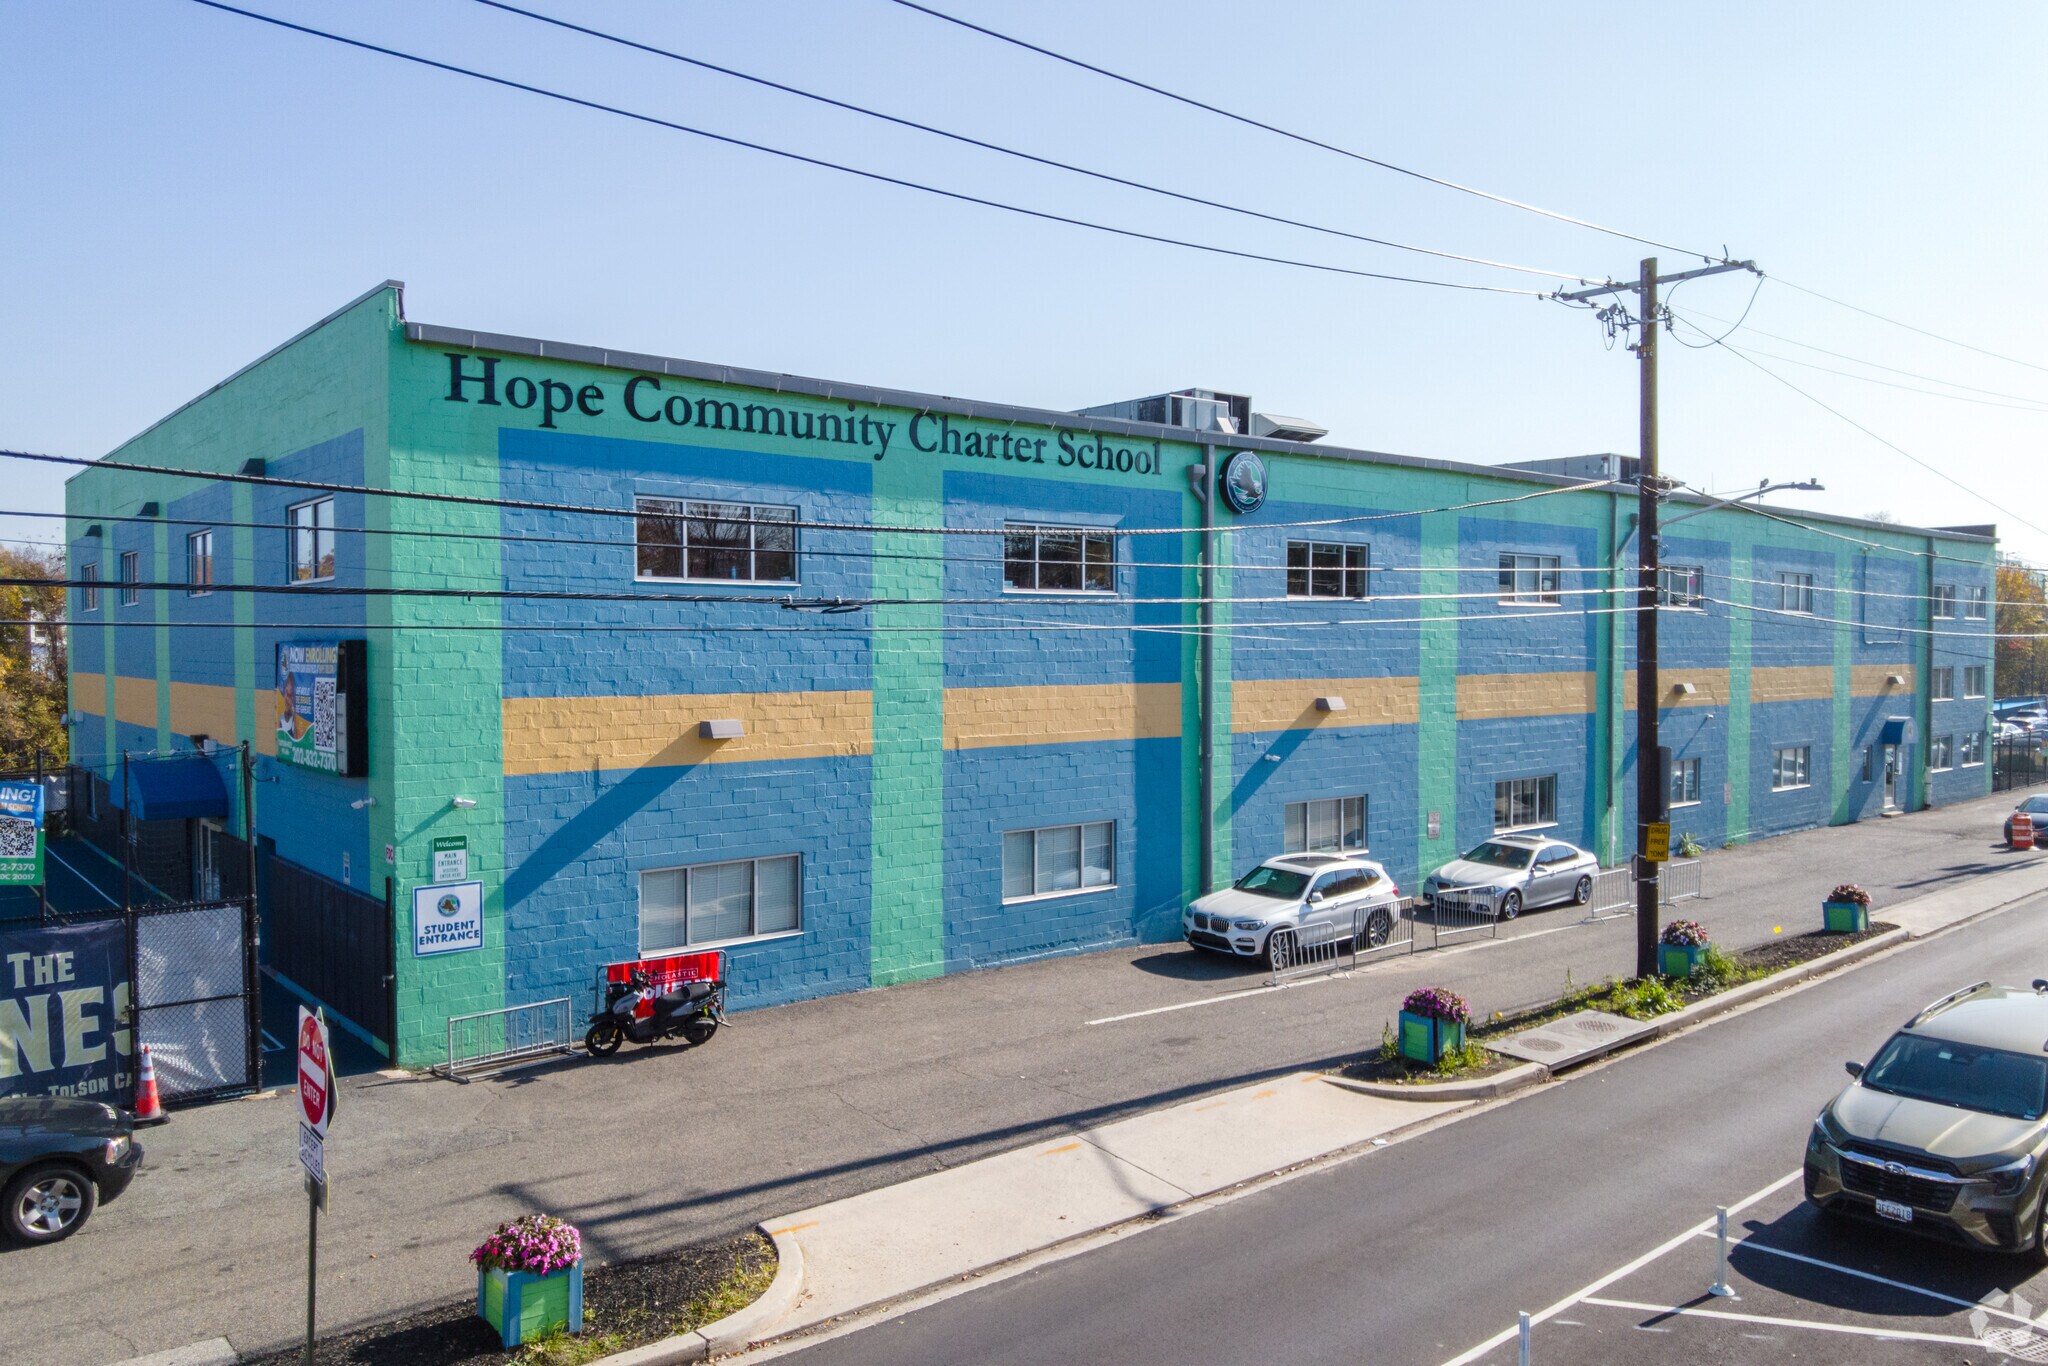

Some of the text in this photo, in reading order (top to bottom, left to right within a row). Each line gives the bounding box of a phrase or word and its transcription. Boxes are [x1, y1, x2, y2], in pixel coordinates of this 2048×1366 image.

[444, 353, 1162, 476] Hope Community Charter School
[290, 647, 304, 663] NOW
[292, 747, 337, 772] 202-832-7370
[436, 840, 464, 848] Welcome
[438, 858, 463, 867] ENTRANCE
[419, 929, 480, 945] ENTRANCE
[424, 920, 475, 935] STUDENT
[7, 951, 75, 989] THE
[649, 969, 697, 981] CHOLASTIC
[303, 1031, 322, 1062] DO NOT
[48, 1077, 109, 1099] TOLSON
[303, 1079, 320, 1108] ENTER
[304, 1131, 318, 1155] EXCEPT
[301, 1144, 320, 1174] BICYCLES
